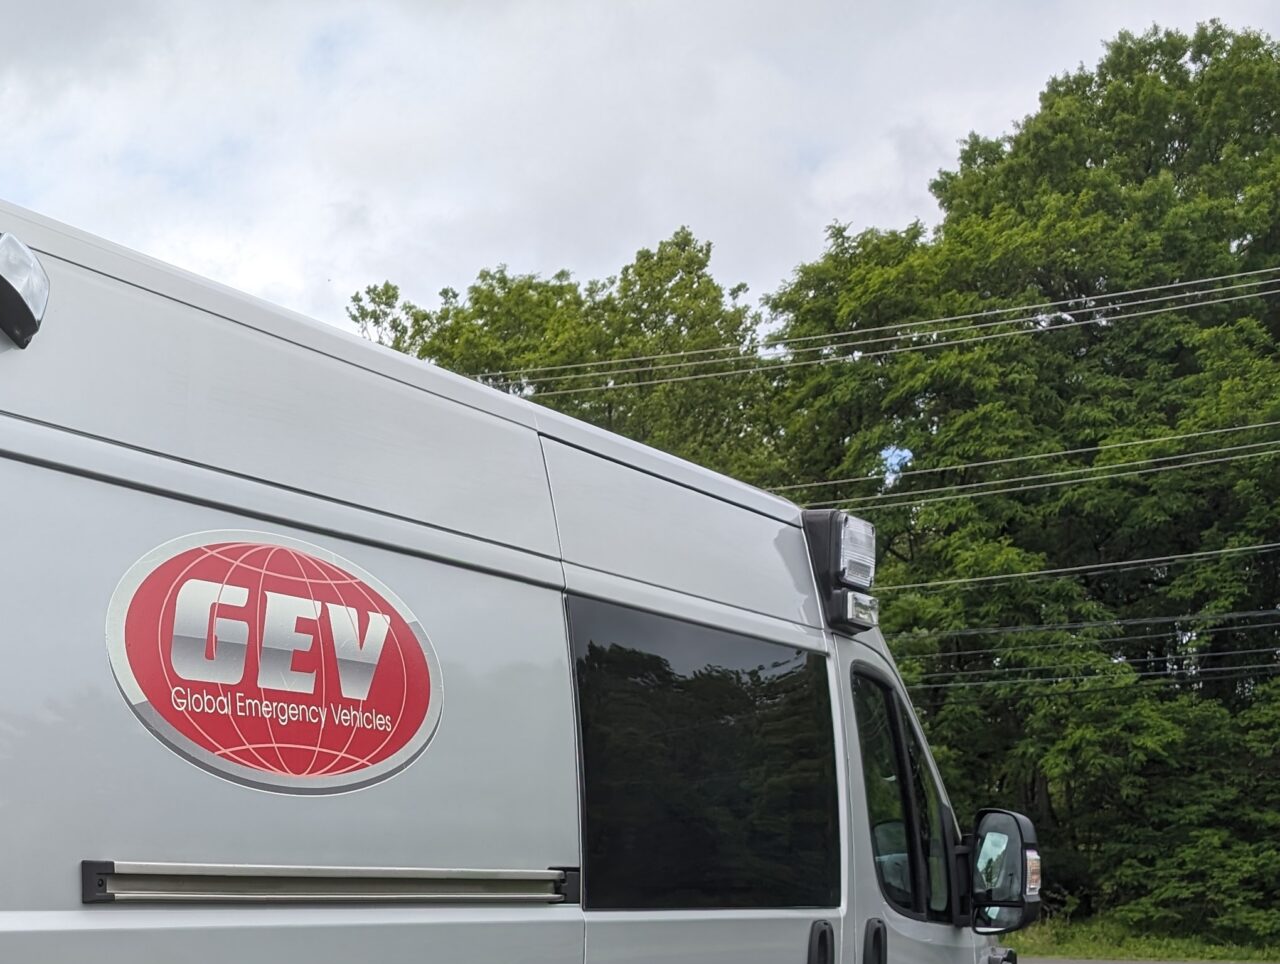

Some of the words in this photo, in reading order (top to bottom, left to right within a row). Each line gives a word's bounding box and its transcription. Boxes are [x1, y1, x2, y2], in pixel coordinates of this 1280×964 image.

[171, 579, 391, 701] GEV
[171, 687, 232, 715] Global
[236, 693, 327, 728] Emergency
[331, 703, 392, 731] Vehicles
